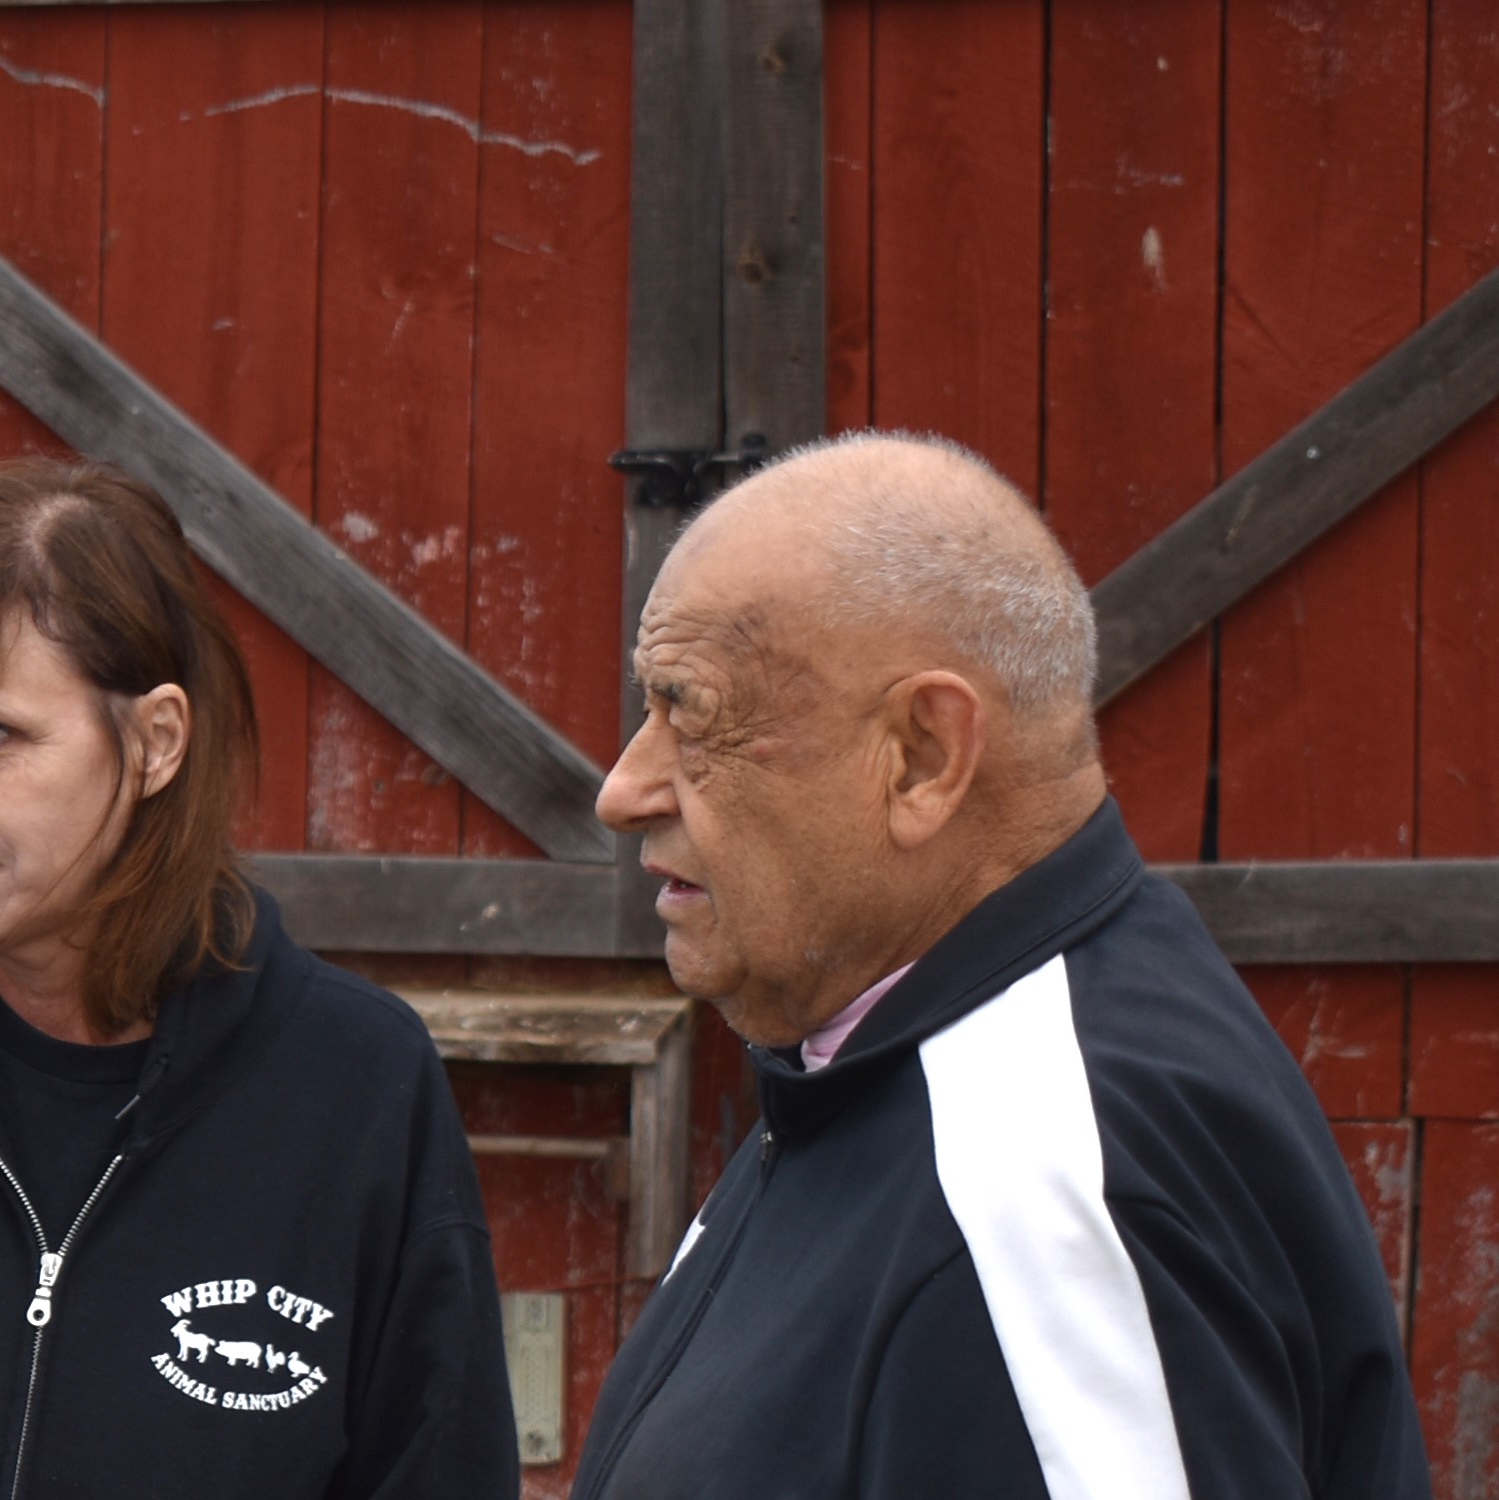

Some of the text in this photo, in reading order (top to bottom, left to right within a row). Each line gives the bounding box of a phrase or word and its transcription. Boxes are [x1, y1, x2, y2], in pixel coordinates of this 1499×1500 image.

[160, 1278, 334, 1332] WHIP CITY
[151, 1352, 328, 1411] ANIMAL SANCTUARY
